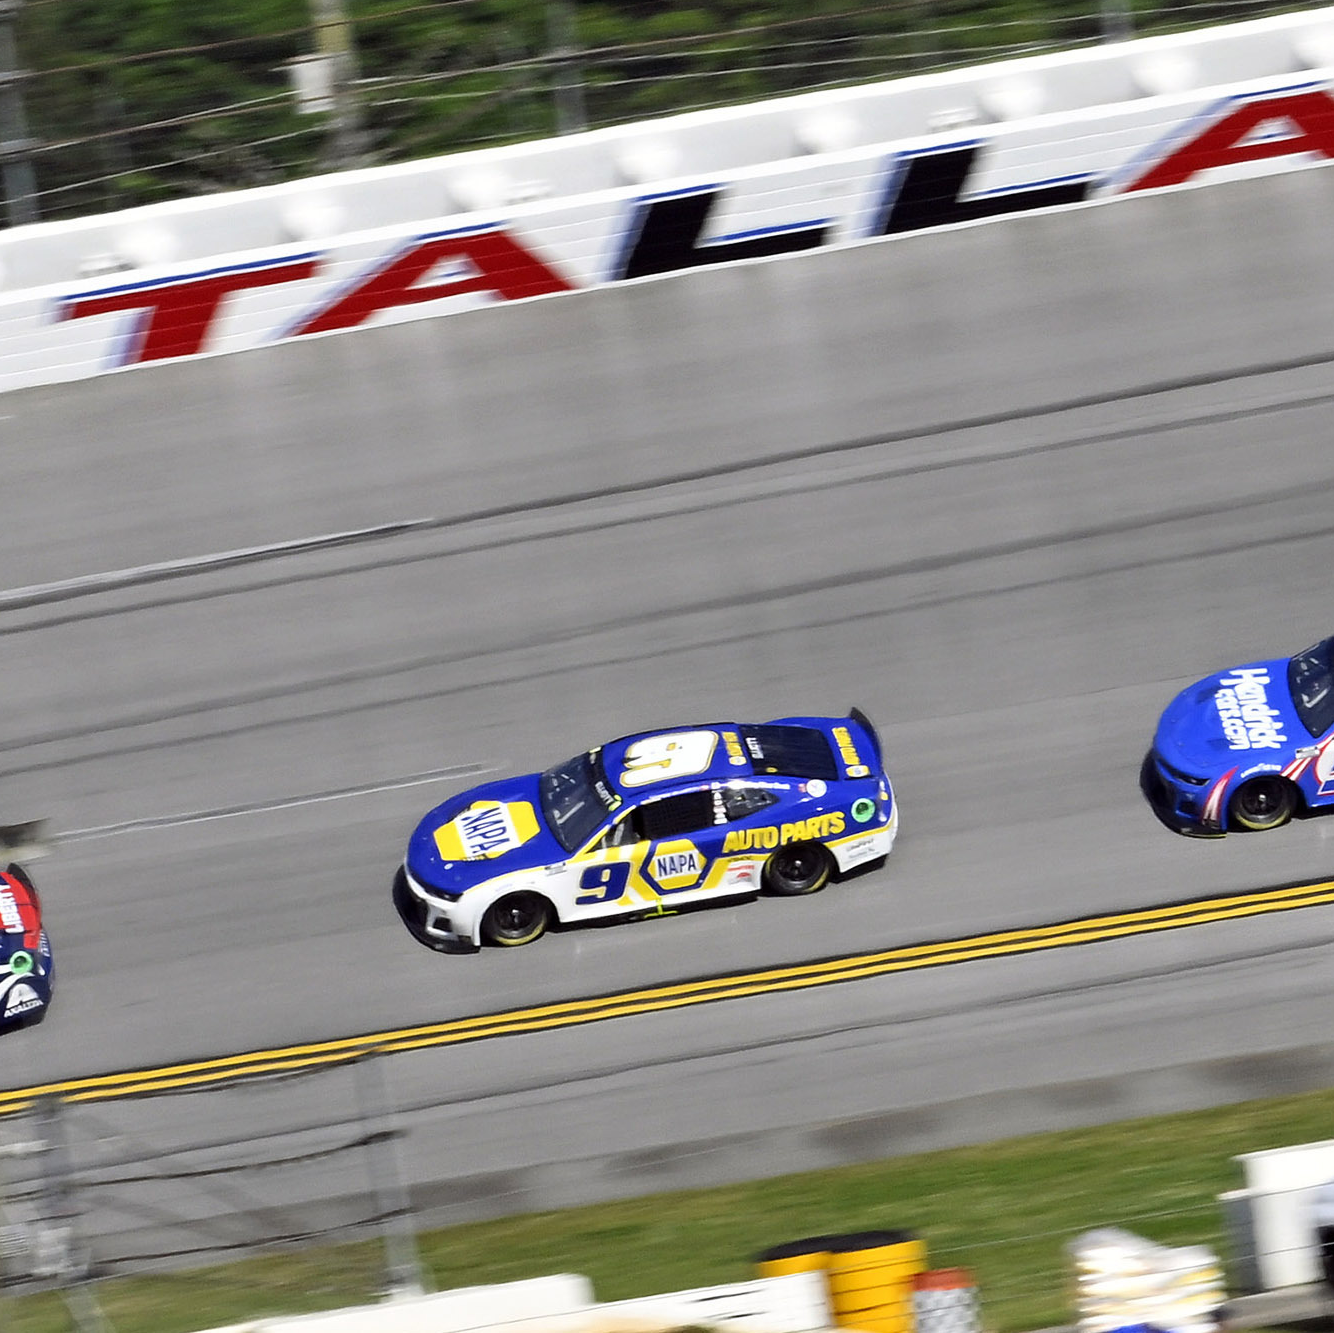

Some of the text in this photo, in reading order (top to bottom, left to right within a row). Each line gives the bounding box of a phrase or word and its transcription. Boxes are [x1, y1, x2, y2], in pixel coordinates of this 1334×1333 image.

[1219, 667, 1288, 749] Hendrick
[620, 730, 719, 788] 9
[460, 807, 511, 854] NAPA
[722, 811, 846, 854] AUTO PARTS
[575, 861, 630, 905] 9
[657, 853, 697, 877] NAPA
